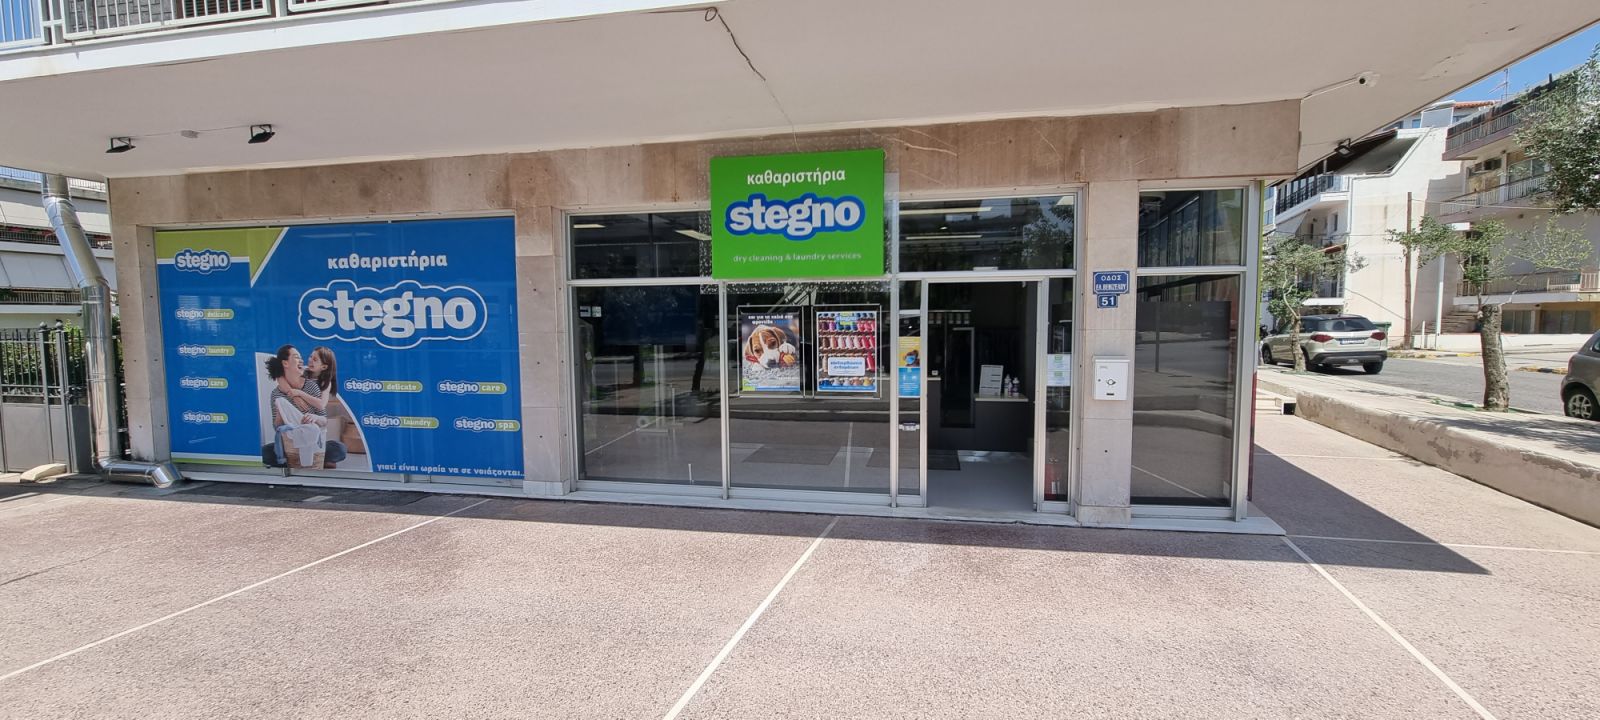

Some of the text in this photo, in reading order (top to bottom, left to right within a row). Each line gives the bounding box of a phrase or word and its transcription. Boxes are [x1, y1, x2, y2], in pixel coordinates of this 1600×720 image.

[747, 168, 846, 187] καθαριστήρια
[730, 198, 860, 236] stegno
[177, 252, 228, 271] stegno
[327, 250, 448, 272] καθαριστήρια
[733, 252, 861, 264] dry cleaning & laundry services
[1101, 274, 1122, 282] ΟΔΟΣ
[1101, 296, 1115, 306] 51
[176, 309, 204, 319] stegno
[308, 290, 477, 338] stegno
[179, 345, 206, 356] stegno
[181, 378, 208, 388] stegno
[346, 379, 417, 392] stegno delicate
[439, 381, 478, 393] stegno
[184, 412, 210, 422] stegno
[363, 414, 431, 428] stegno laundry
[455, 418, 514, 431] stegno spa
[376, 463, 397, 472] γιατί
[398, 463, 418, 472] είναι
[420, 464, 446, 473] ωραία
